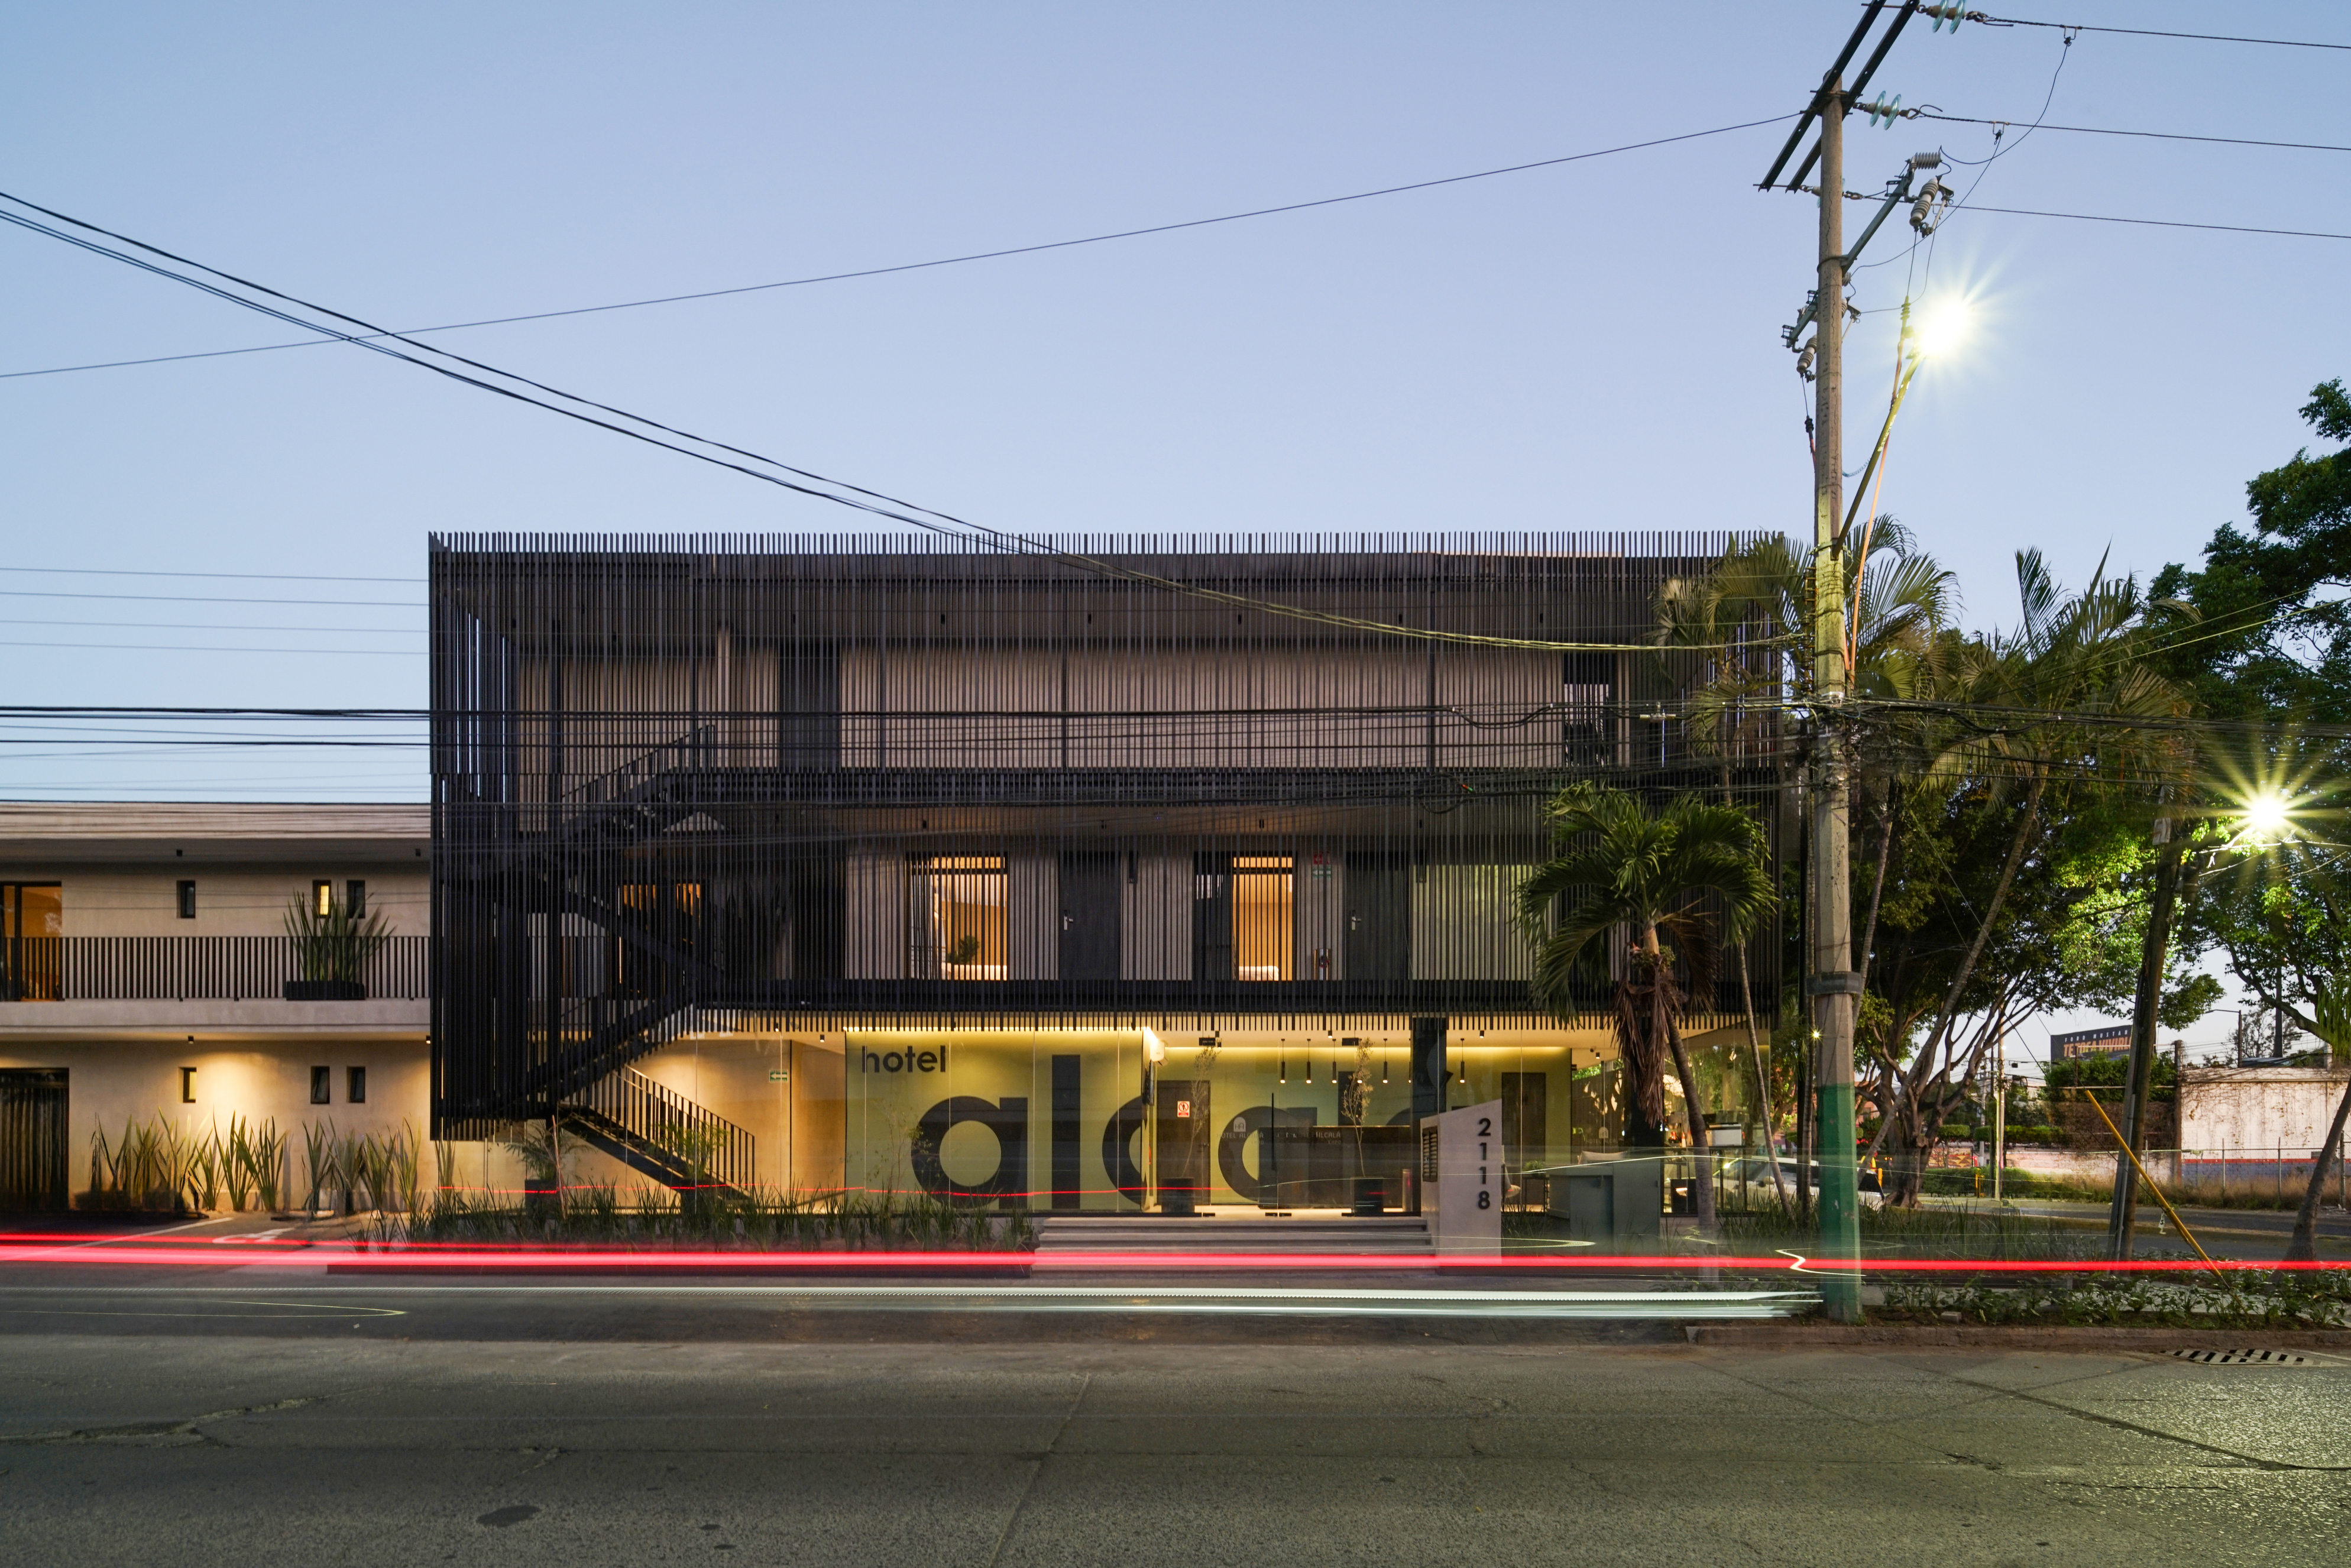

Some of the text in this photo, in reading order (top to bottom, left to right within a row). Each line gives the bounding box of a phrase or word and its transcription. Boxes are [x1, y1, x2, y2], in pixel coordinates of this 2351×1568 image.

[2064, 1029, 2128, 1043] FORD MUSTAN
[2064, 1043, 2074, 1057] TE
[2099, 1036, 2132, 1053] VIVIRL
[862, 1045, 945, 1073] hotel
[1478, 1117, 1491, 1210] 2118
